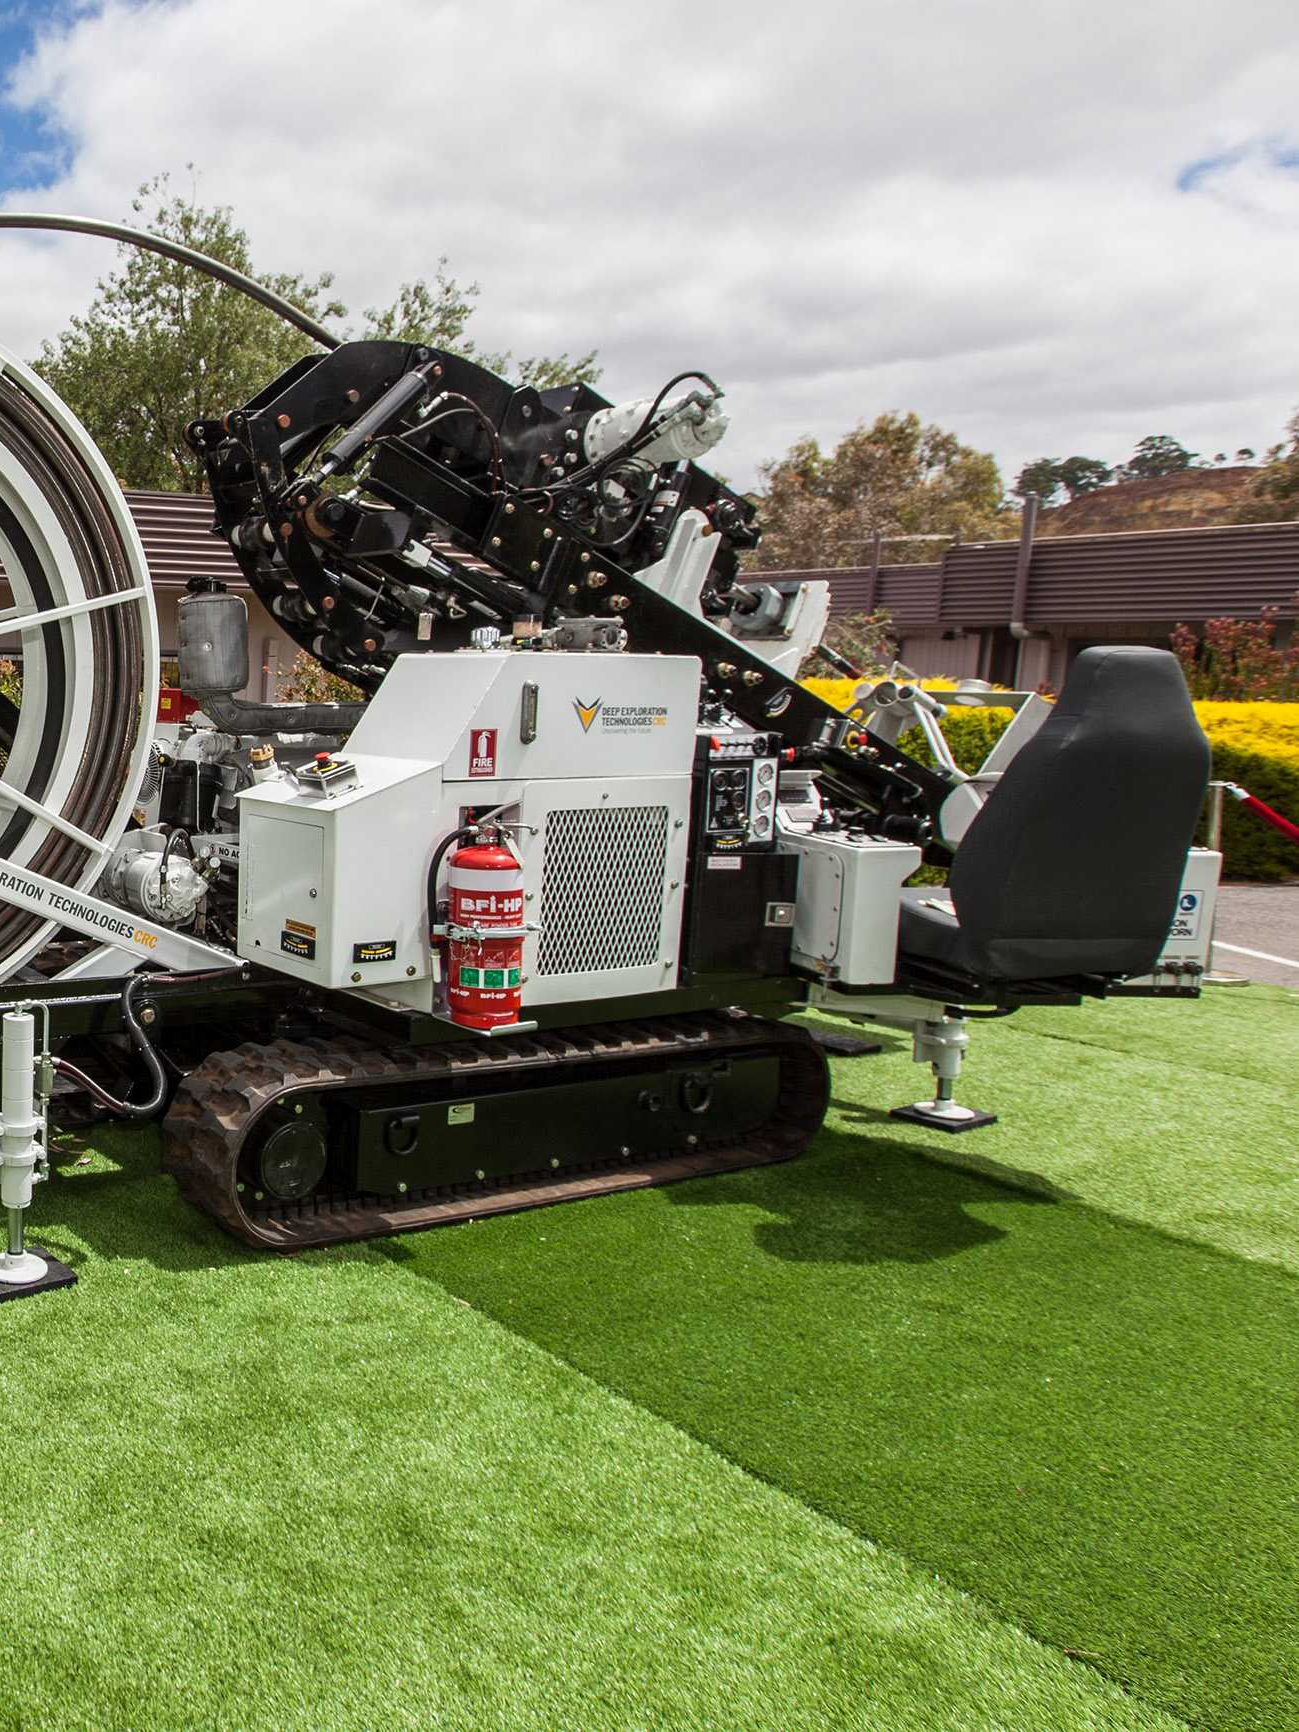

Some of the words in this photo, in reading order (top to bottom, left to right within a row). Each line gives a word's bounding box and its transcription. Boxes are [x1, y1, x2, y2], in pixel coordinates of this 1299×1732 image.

[602, 706, 620, 716] DEEP
[621, 706, 668, 716] EXPLORATION
[602, 717, 652, 726] TECHNOLOGIES
[473, 757, 493, 768] FIRE
[218, 847, 230, 857] NO
[48, 892, 135, 939] TECHNOLOGIES
[134, 930, 158, 949] CRC
